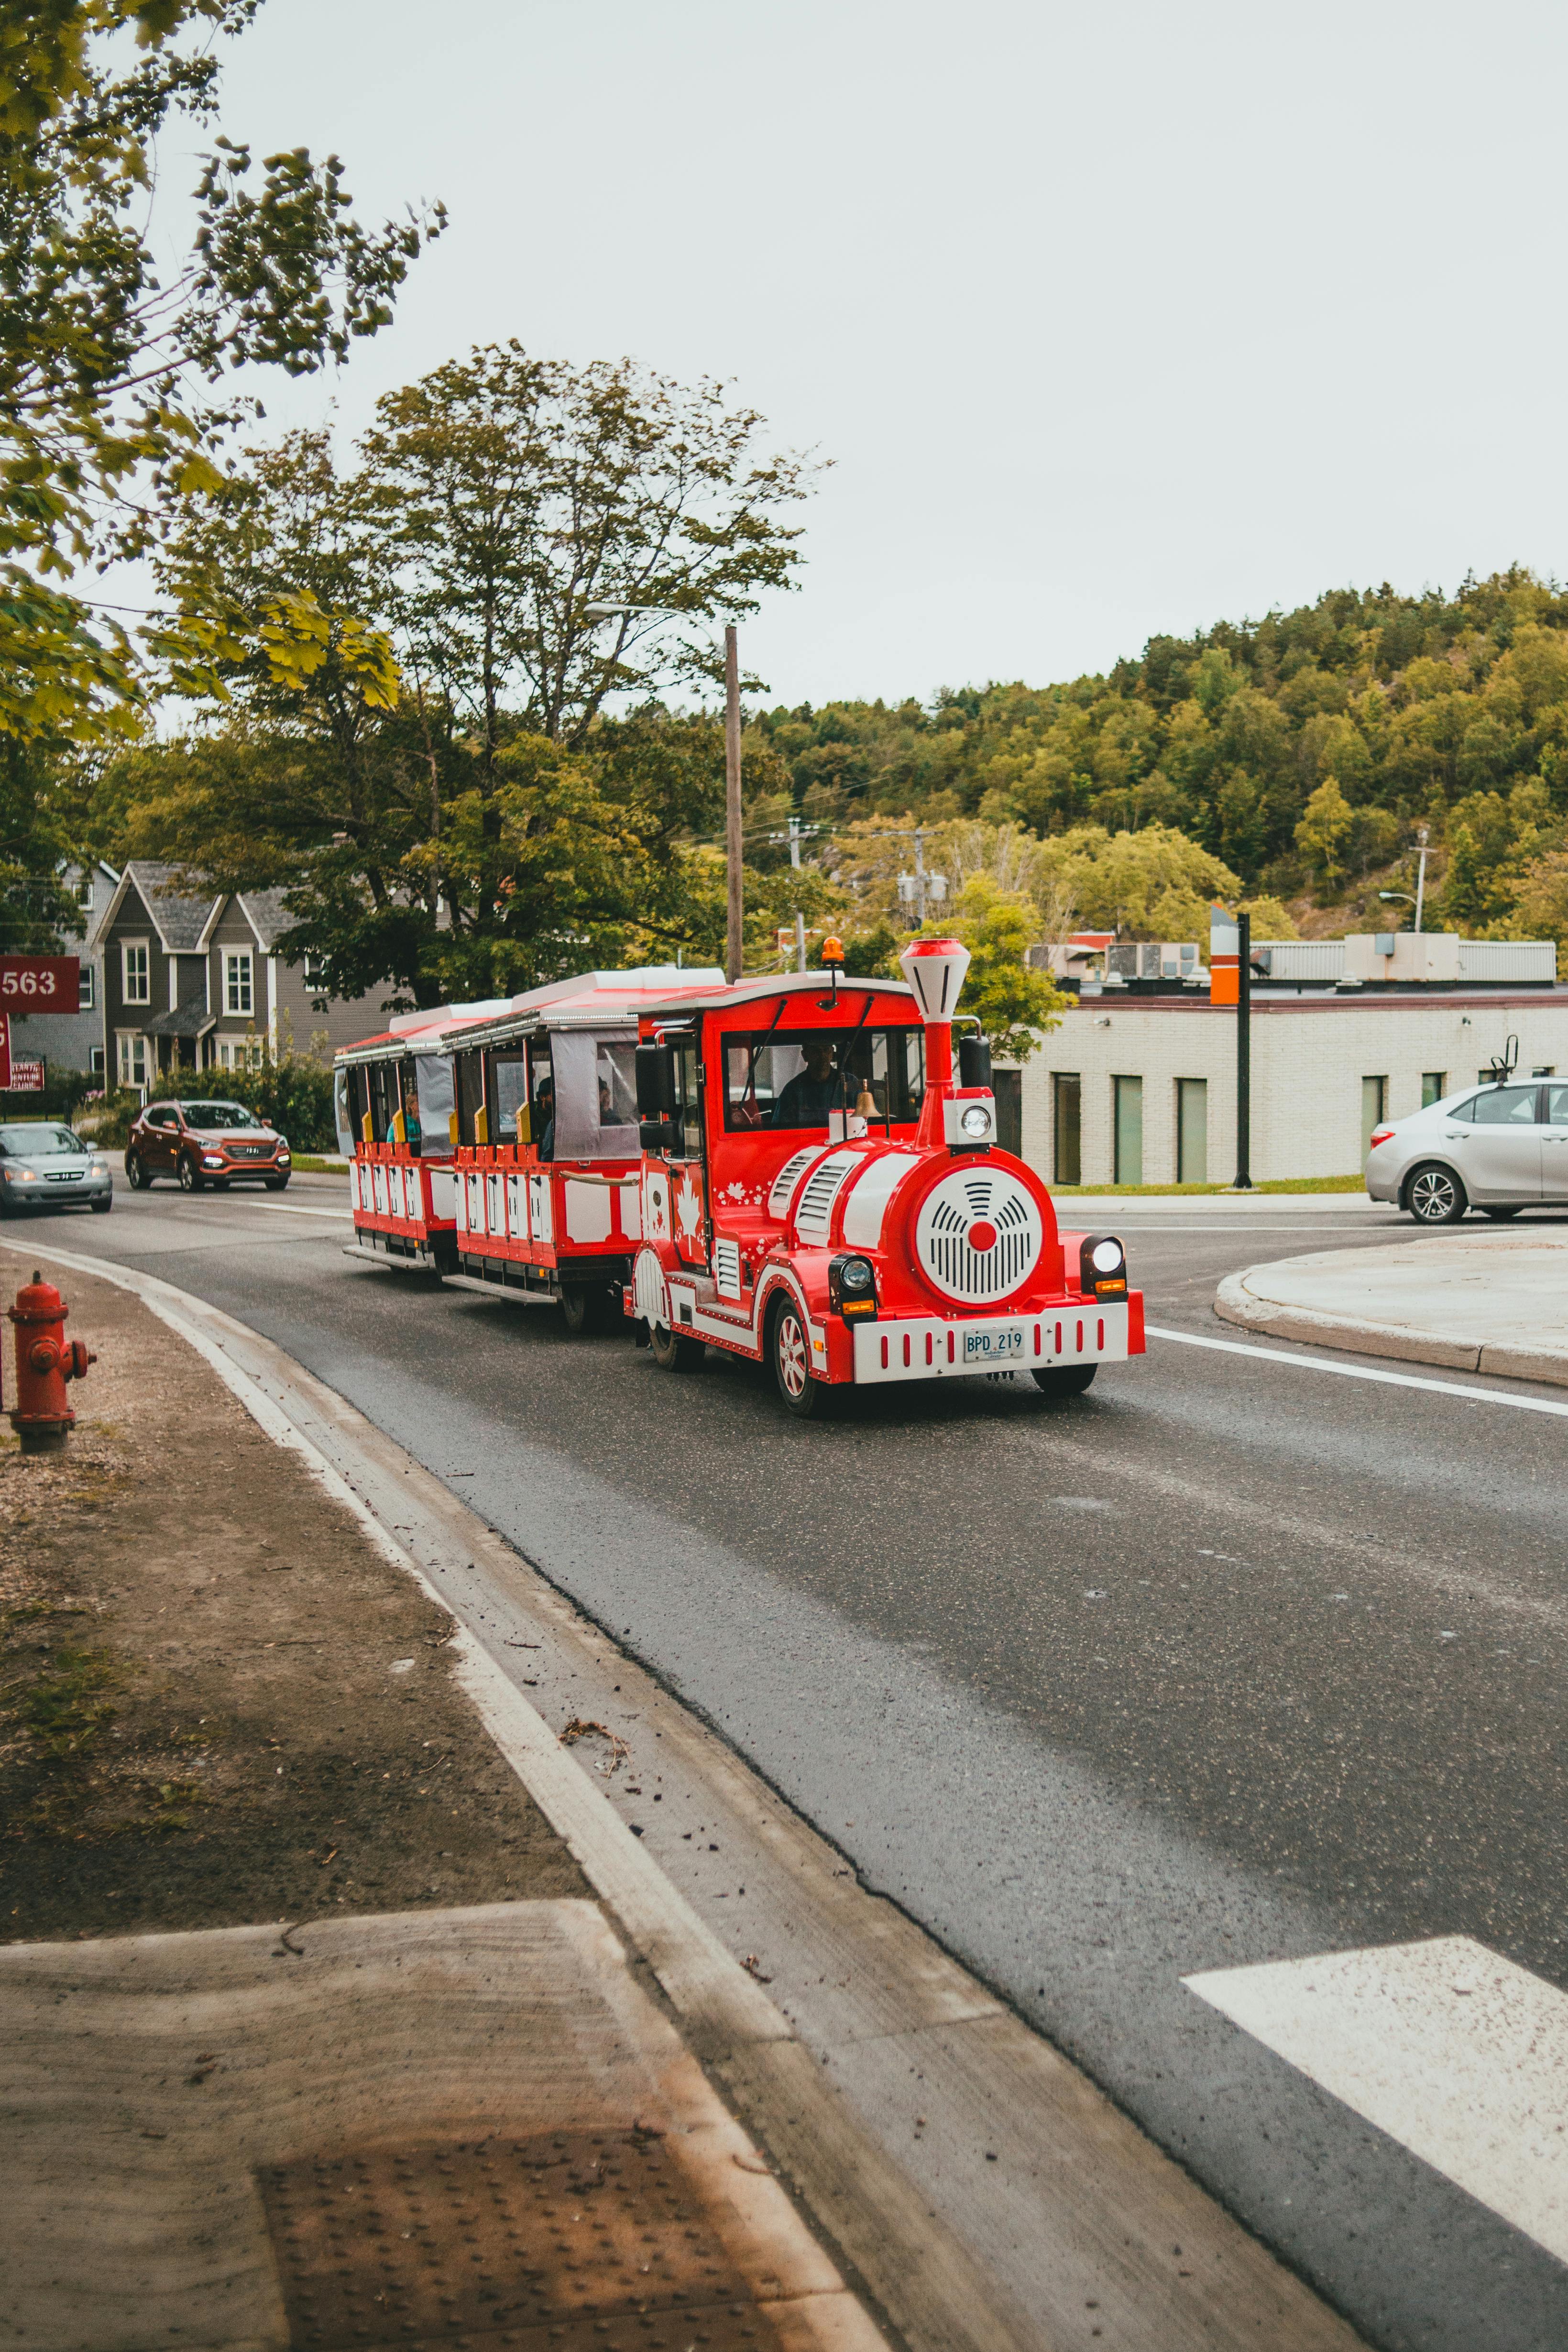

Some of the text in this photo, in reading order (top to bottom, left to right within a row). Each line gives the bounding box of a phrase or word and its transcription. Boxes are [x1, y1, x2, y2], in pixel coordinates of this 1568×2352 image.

[2, 971, 55, 995] 563
[967, 1333, 1021, 1352] BPD 219
